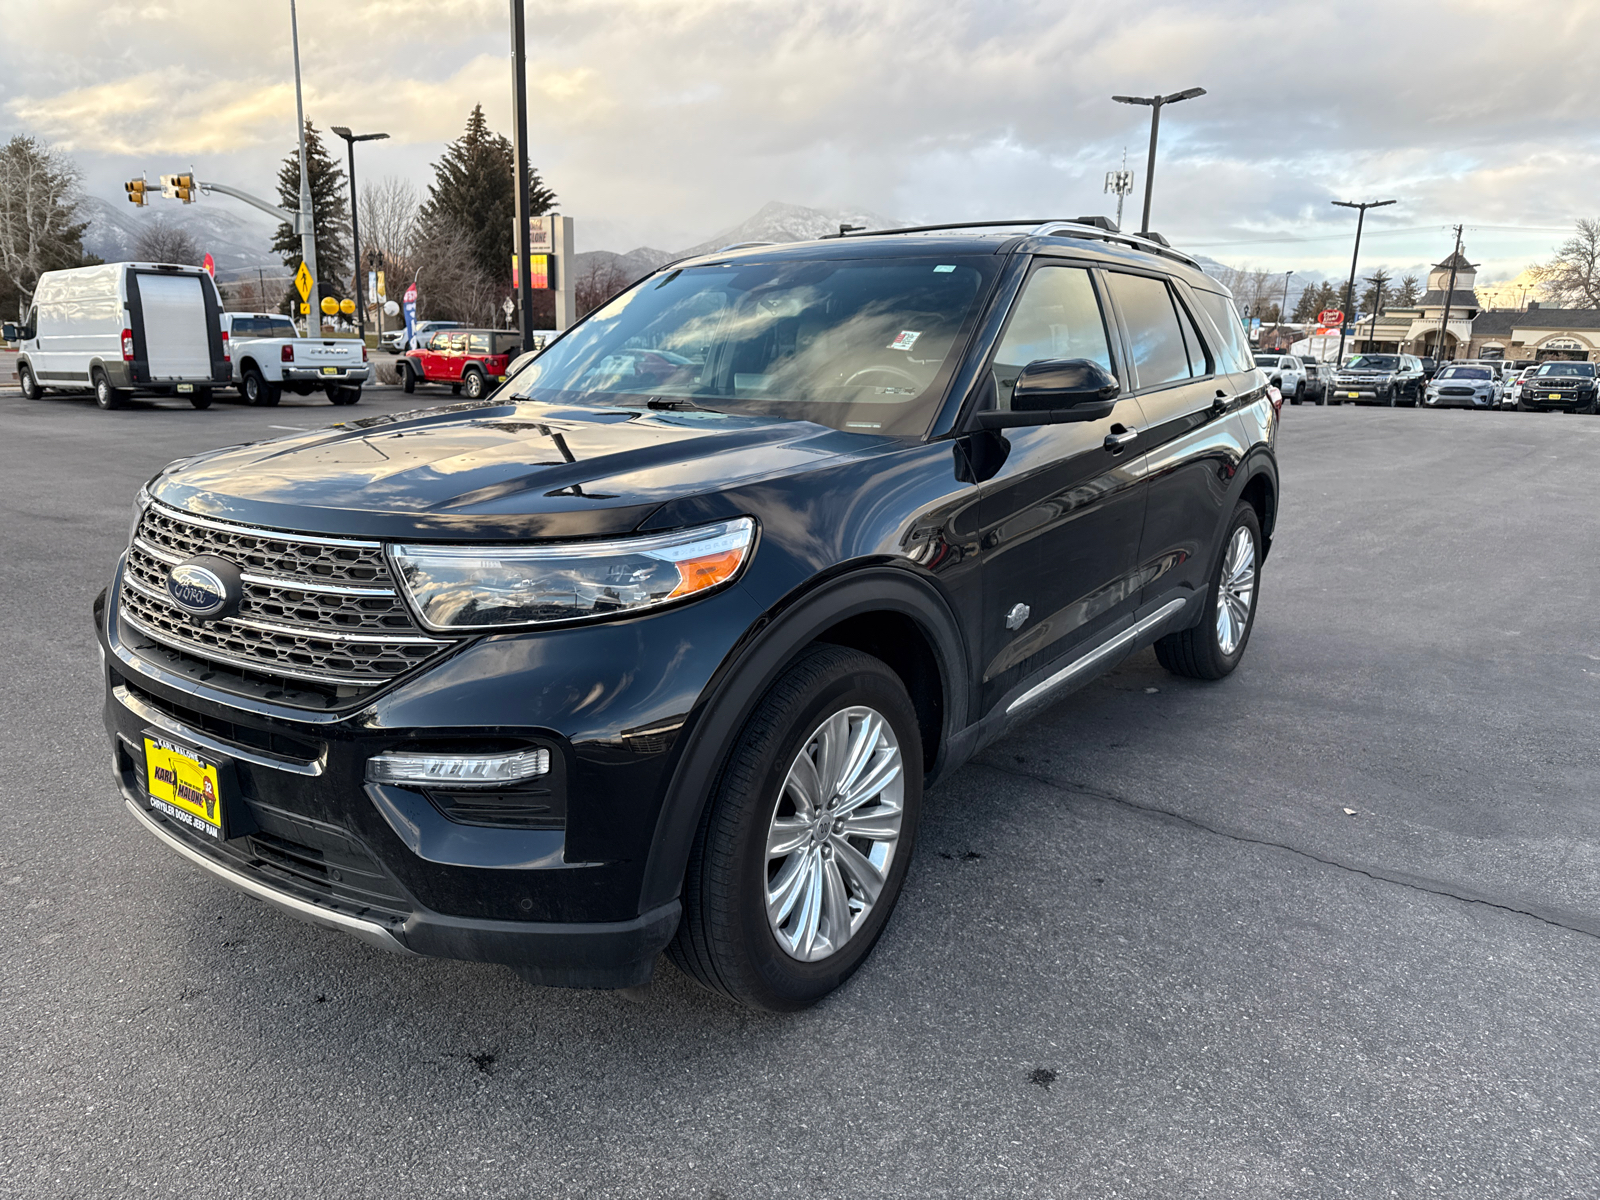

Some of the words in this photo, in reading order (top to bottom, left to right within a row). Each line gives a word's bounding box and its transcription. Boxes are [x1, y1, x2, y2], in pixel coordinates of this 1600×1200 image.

[175, 574, 206, 604] Ford
[158, 738, 174, 752] KARL
[175, 745, 199, 762] MALONE
[154, 766, 173, 785] KARL
[178, 784, 203, 807] MALONE
[204, 781, 212, 794] 32
[150, 797, 175, 817] CHRYSLER
[175, 808, 193, 826] DODGE
[193, 817, 206, 831] JEEP
[206, 824, 218, 838] RAM
